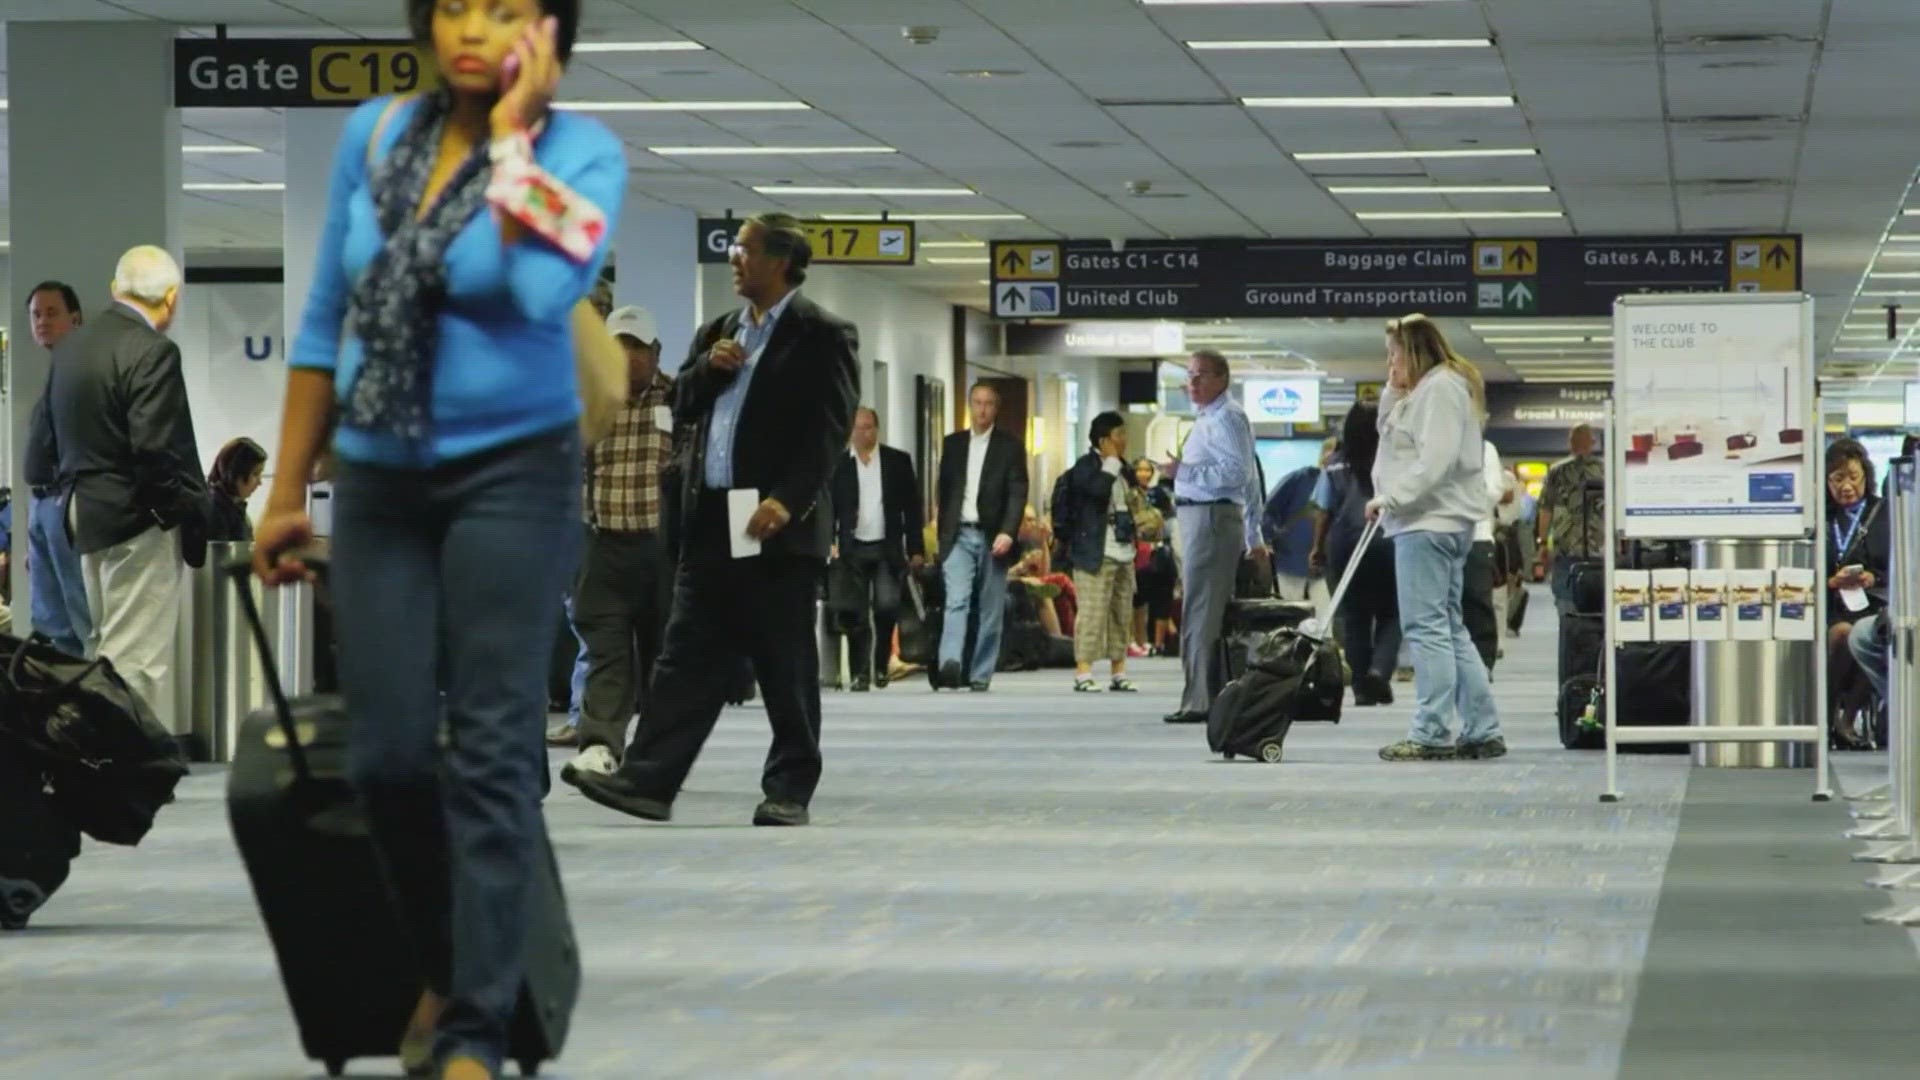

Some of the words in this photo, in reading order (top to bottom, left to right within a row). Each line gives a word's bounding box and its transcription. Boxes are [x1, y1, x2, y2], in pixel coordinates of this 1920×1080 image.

[188, 56, 299, 90] Gate
[318, 52, 419, 94] C19
[807, 229, 859, 256] 17
[1067, 254, 1120, 269] Gates
[1127, 254, 1147, 268] C1
[1164, 253, 1199, 269] C14
[1325, 252, 1407, 270] Baggage
[1414, 250, 1467, 266] Claim
[1584, 250, 1638, 265] Gates
[1067, 290, 1130, 306] United
[1136, 289, 1178, 306] Club
[1246, 288, 1316, 305] Ground
[1322, 287, 1467, 307] Transportation
[1632, 323, 1696, 334] WELCOME
[1701, 322, 1717, 333] TO
[1632, 337, 1656, 349] THE
[1661, 337, 1694, 348] CLUB
[1514, 408, 1556, 420] Ground
